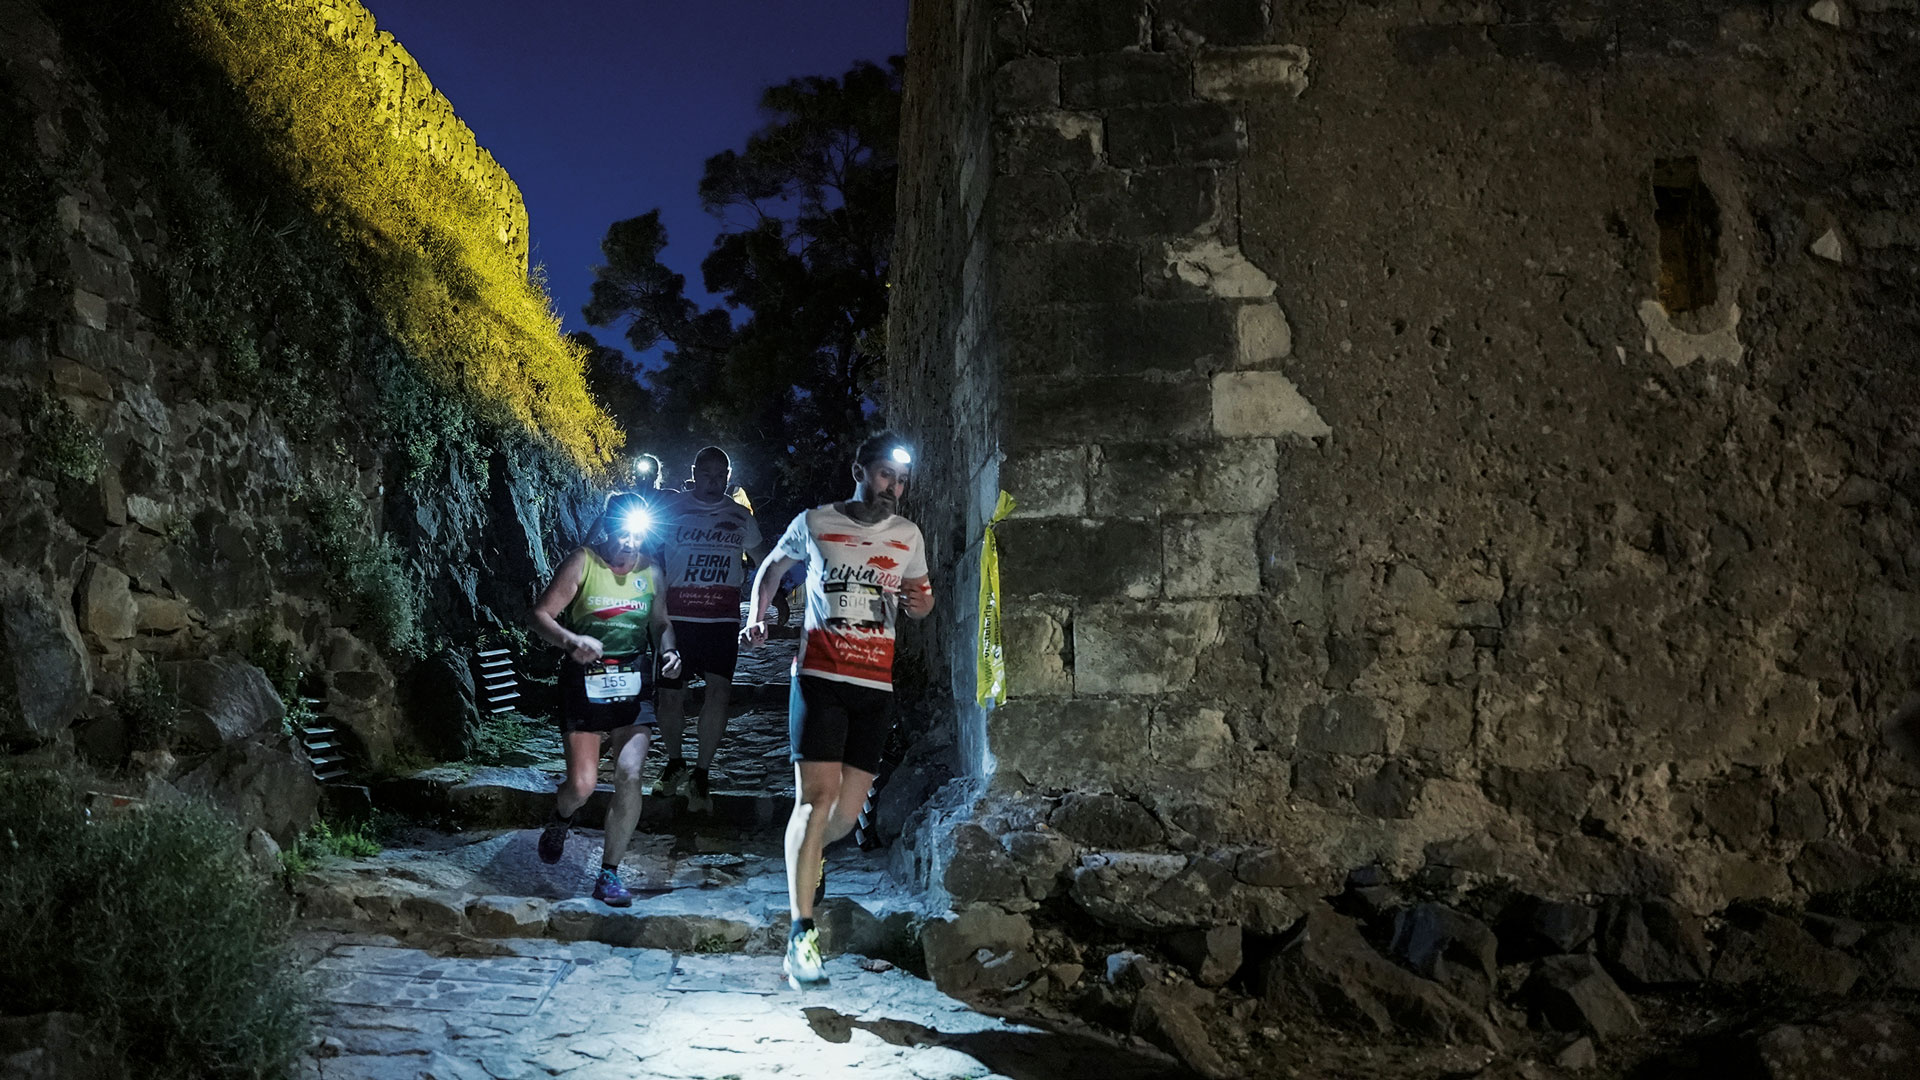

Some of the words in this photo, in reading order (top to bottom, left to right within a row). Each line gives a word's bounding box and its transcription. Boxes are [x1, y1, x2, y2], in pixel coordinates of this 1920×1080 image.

[687, 554, 731, 568] LEIRIA
[684, 568, 729, 583] RUN
[601, 676, 627, 688] 155
